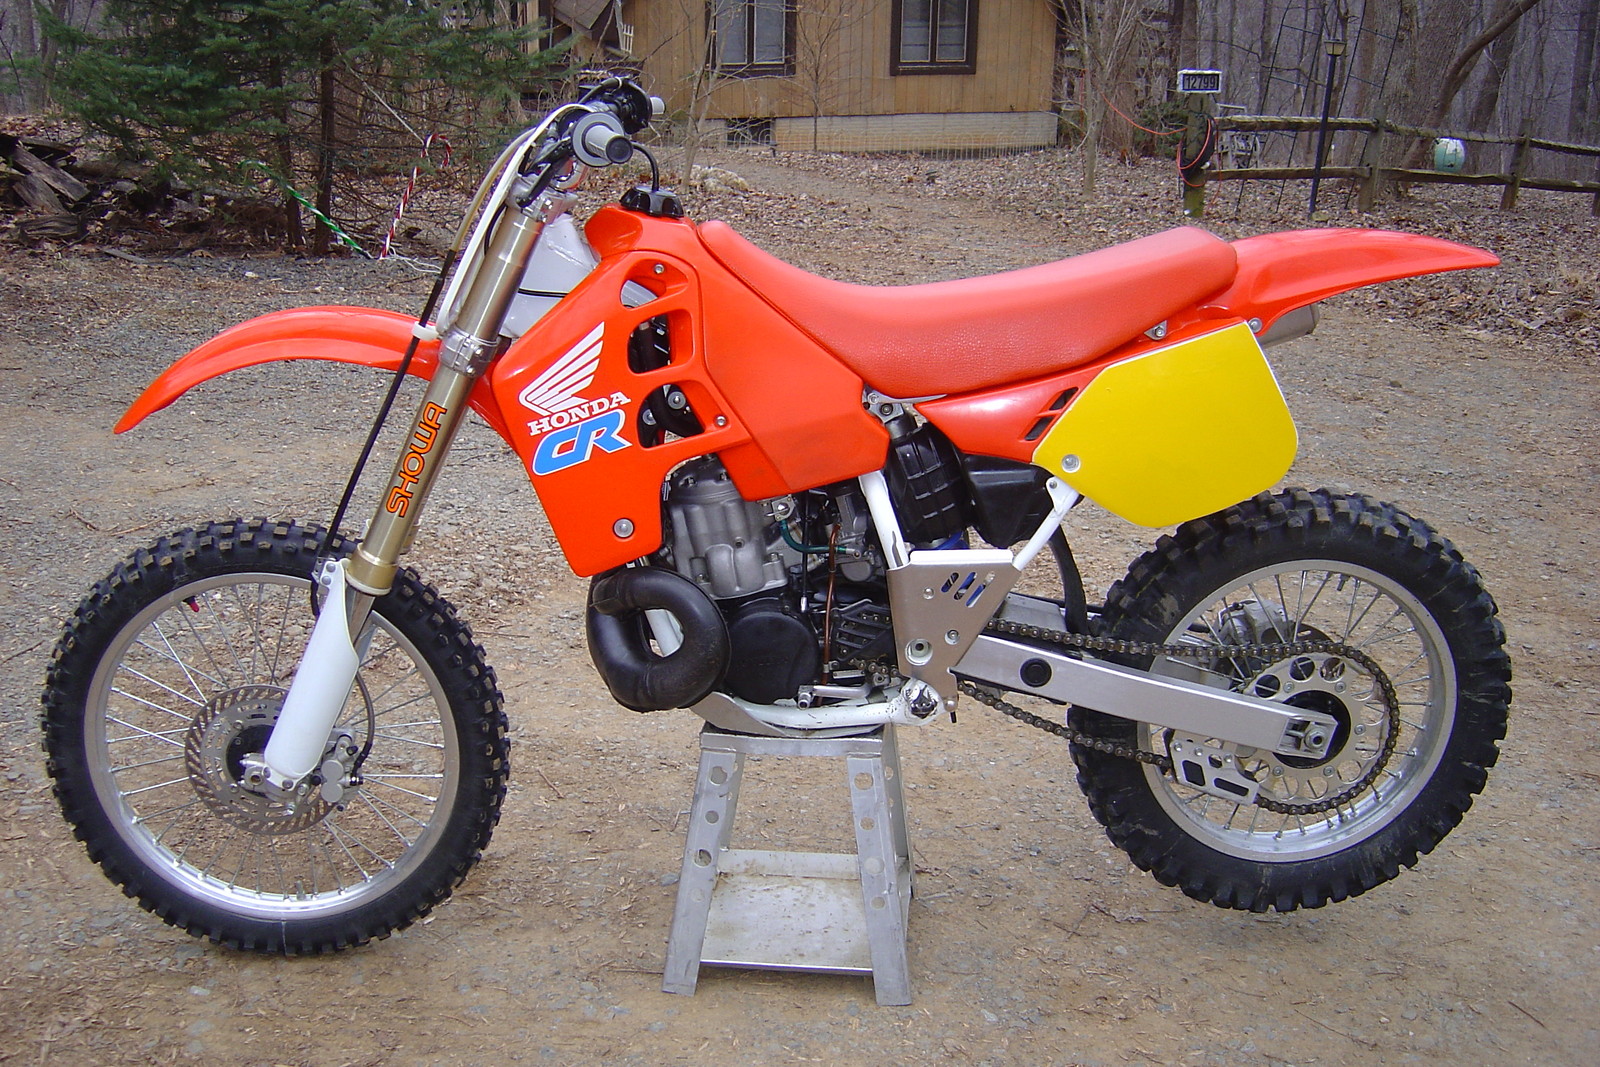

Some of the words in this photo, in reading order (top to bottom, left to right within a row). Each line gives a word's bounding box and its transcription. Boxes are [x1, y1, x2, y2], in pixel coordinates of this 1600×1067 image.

[1185, 75, 1216, 89] 12799
[527, 391, 632, 436] HONDA
[386, 401, 448, 518] SHOWA
[532, 408, 633, 476] CR
